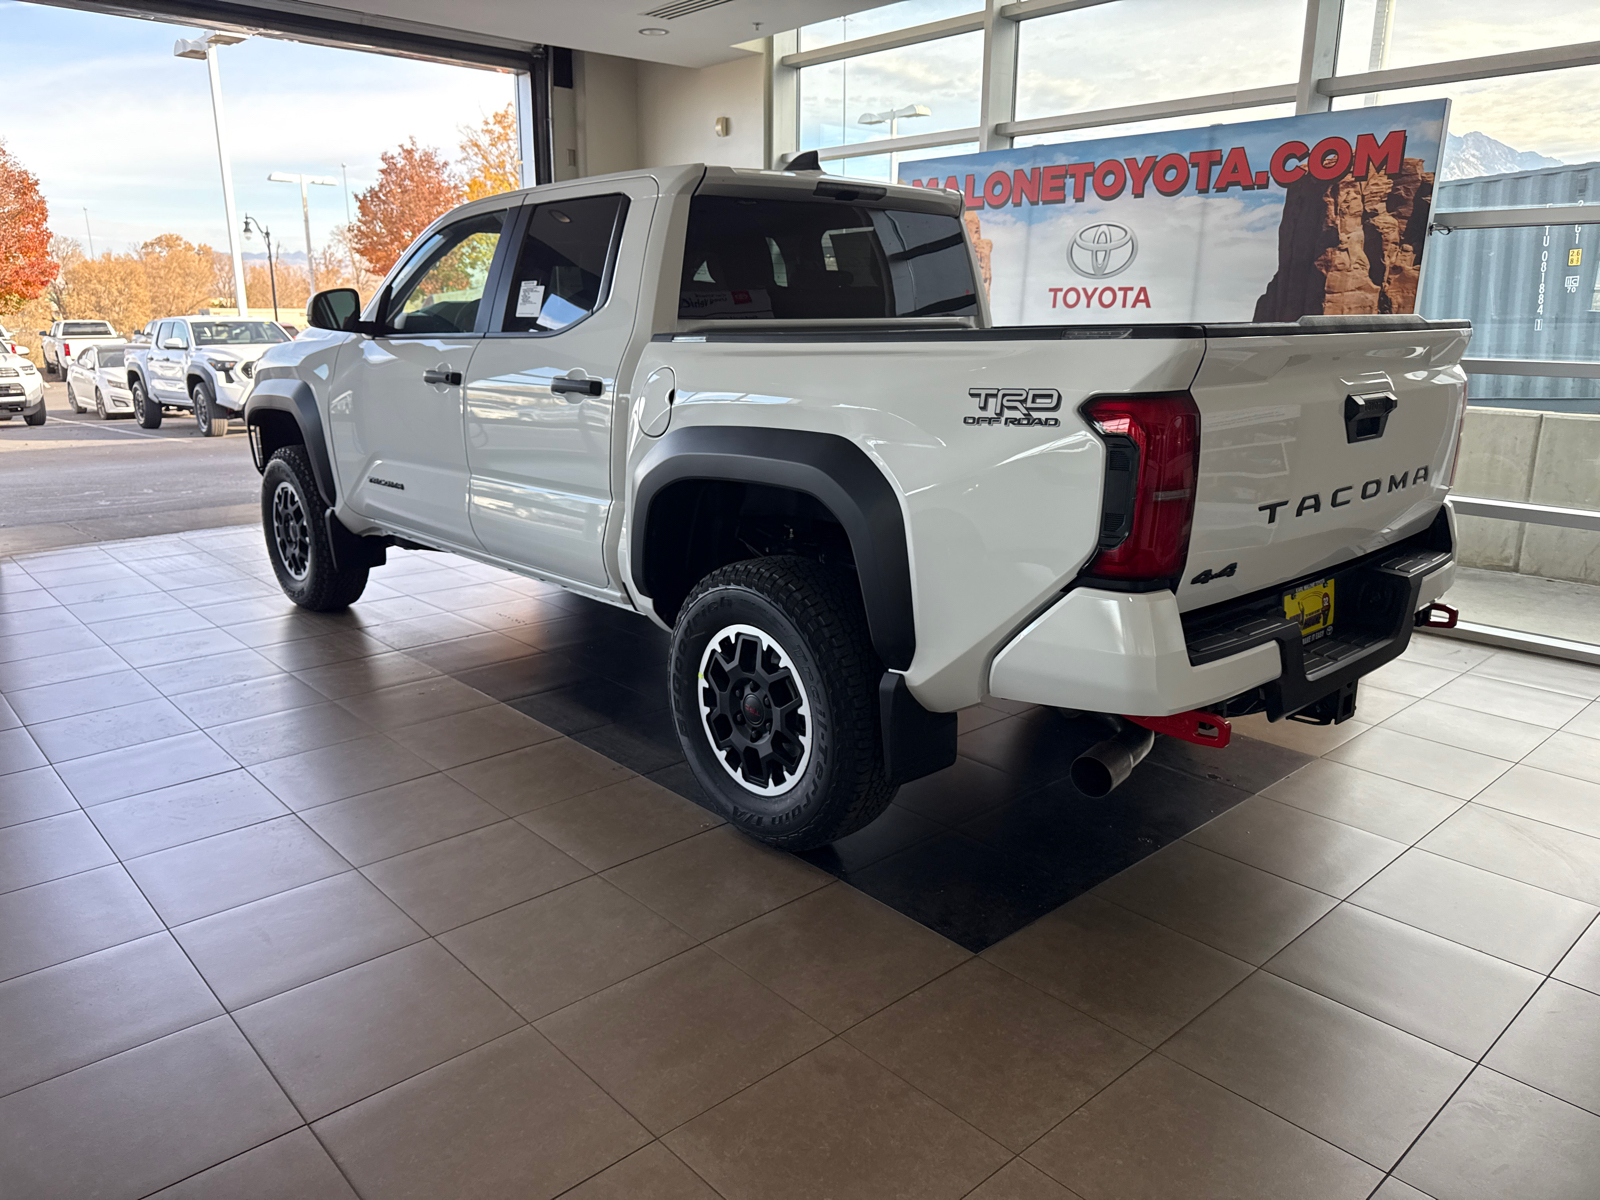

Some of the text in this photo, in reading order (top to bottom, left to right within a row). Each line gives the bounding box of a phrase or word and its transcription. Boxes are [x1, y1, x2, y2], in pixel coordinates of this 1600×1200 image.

[912, 130, 1406, 210] LONETOYOTA.COM
[1048, 286, 1152, 309] TOYOTA
[968, 388, 1062, 418] TRD
[963, 416, 1061, 427] OFF ROAD
[1258, 465, 1429, 524] TACOMA
